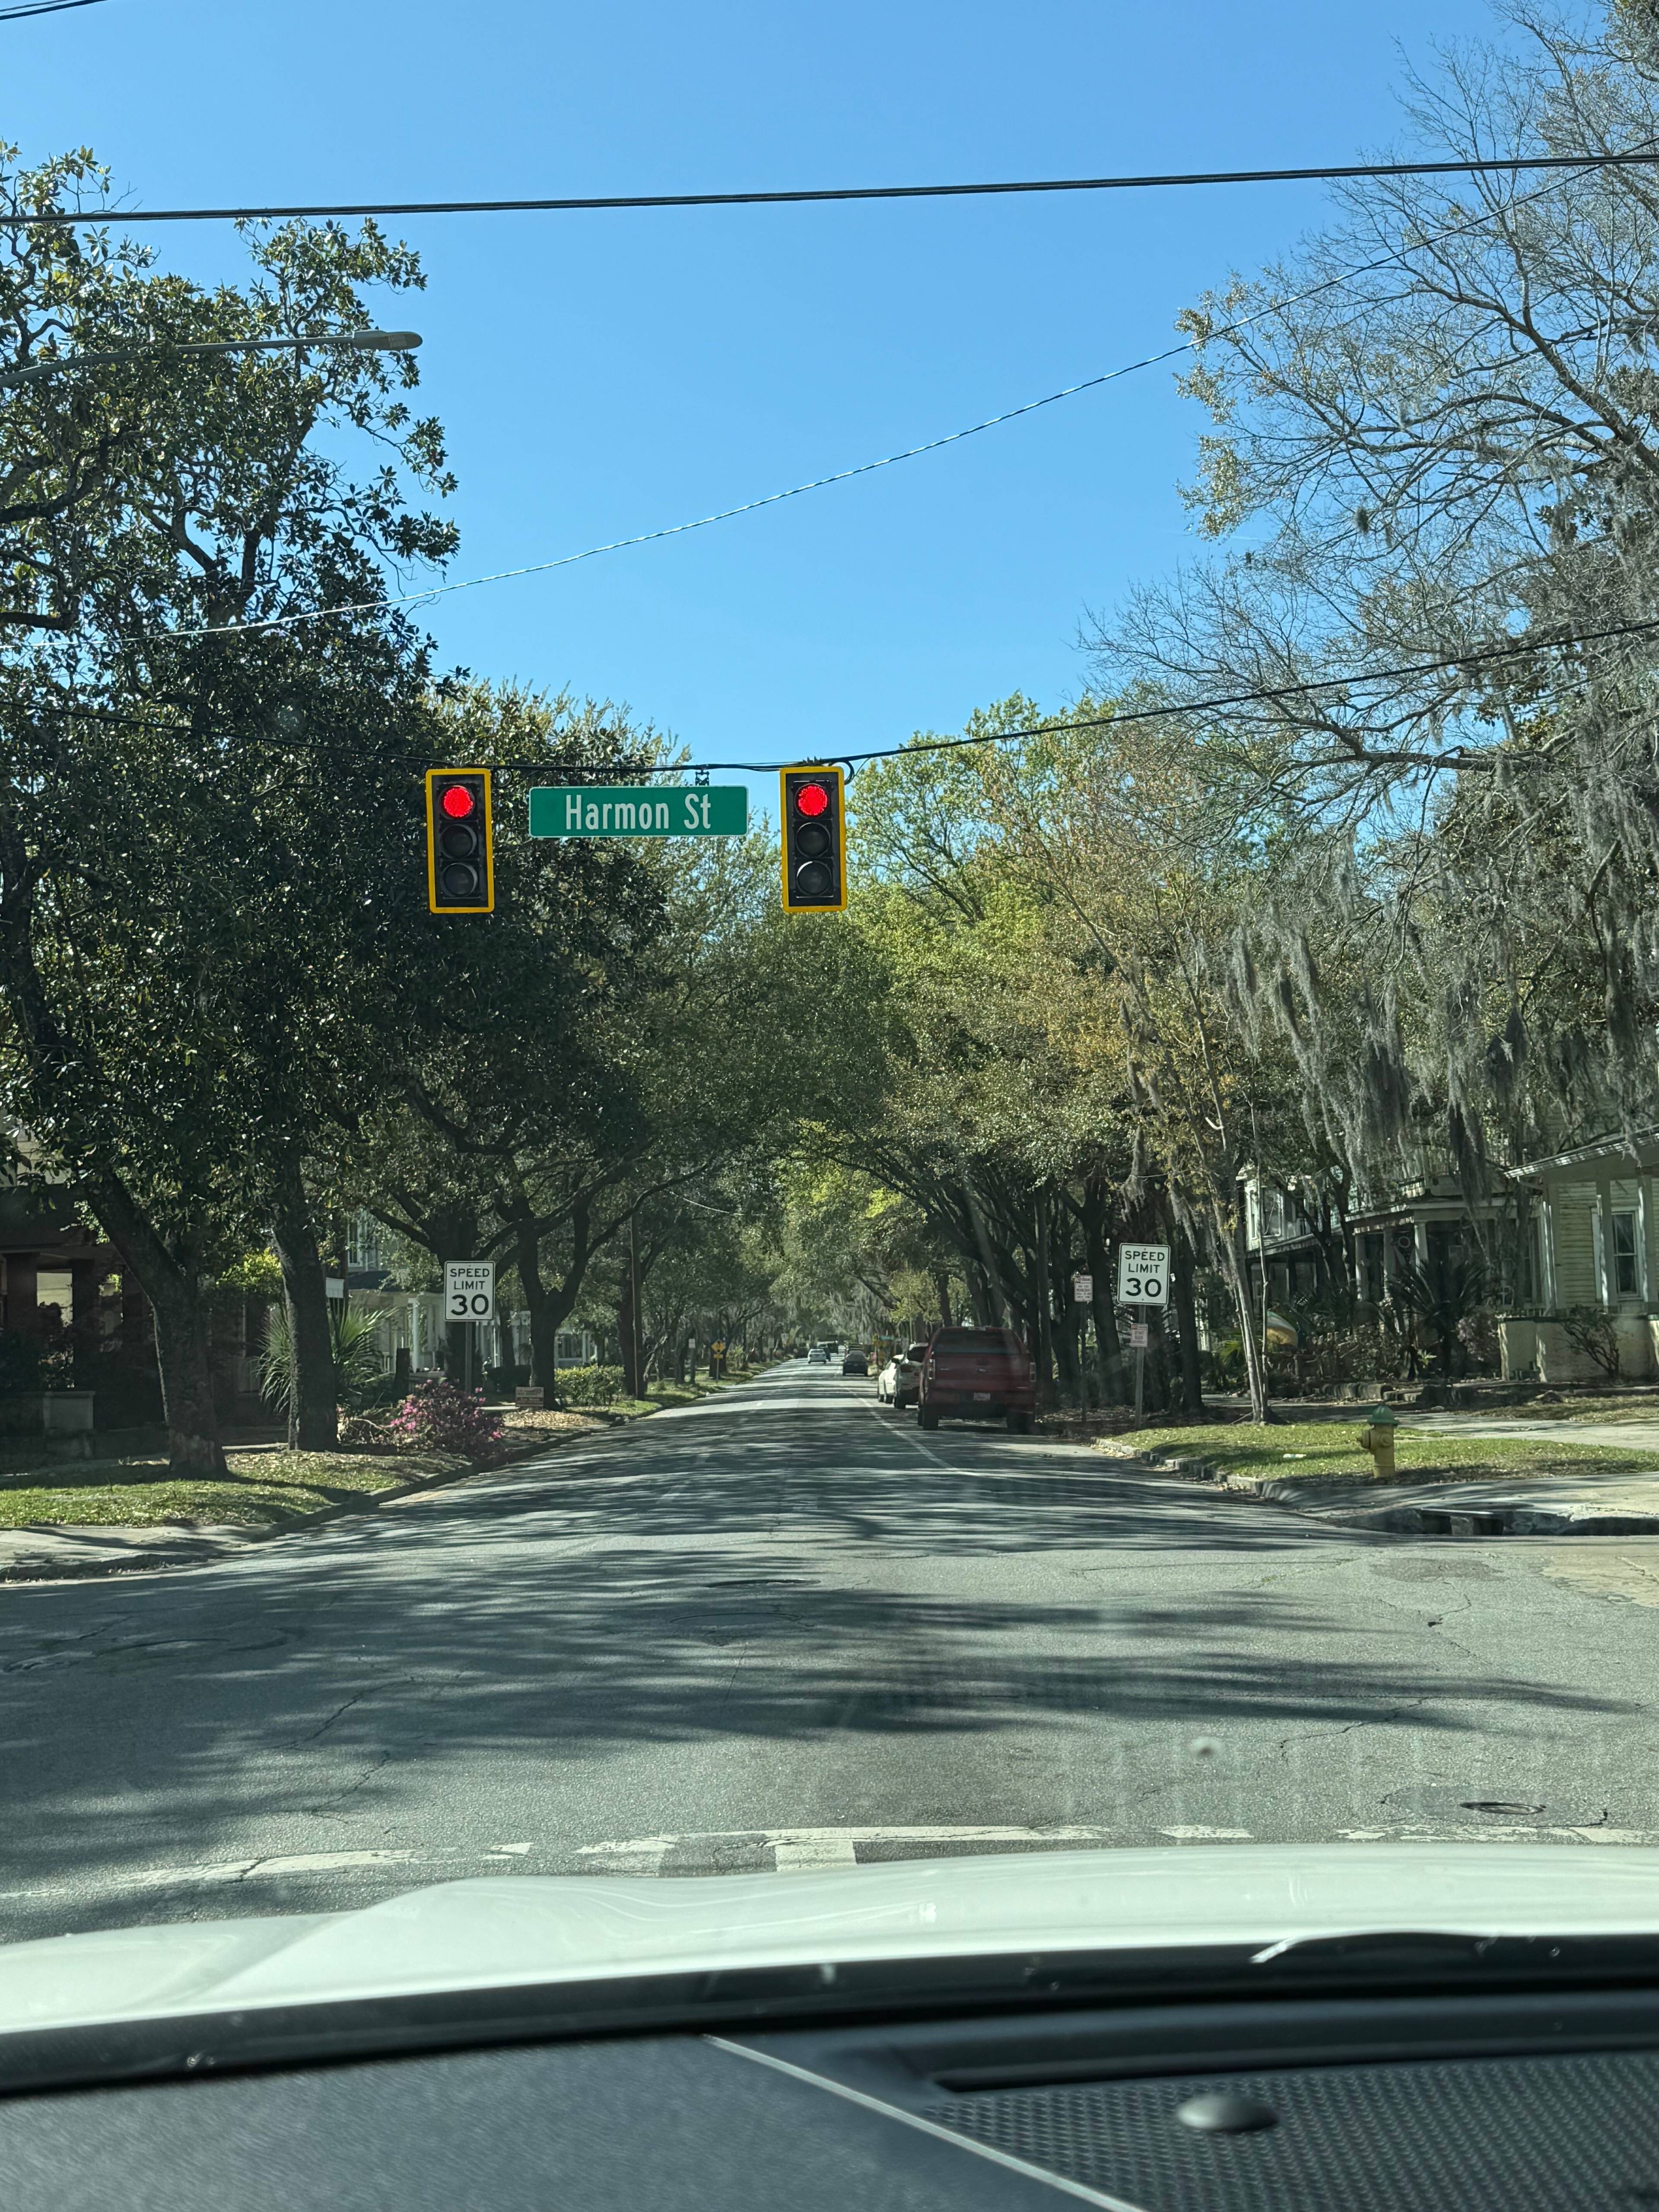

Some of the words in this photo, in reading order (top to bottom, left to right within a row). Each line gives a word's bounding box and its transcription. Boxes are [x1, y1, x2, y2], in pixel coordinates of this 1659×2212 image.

[566, 795, 669, 830] Harmon
[684, 793, 711, 829] St
[1125, 1250, 1165, 1261] SPEED
[450, 1268, 490, 1277] SPEED
[1128, 1263, 1160, 1273] LIMIT
[454, 1281, 486, 1290] LIMIT
[1125, 1278, 1161, 1297] 30
[451, 1294, 489, 1316] 30
